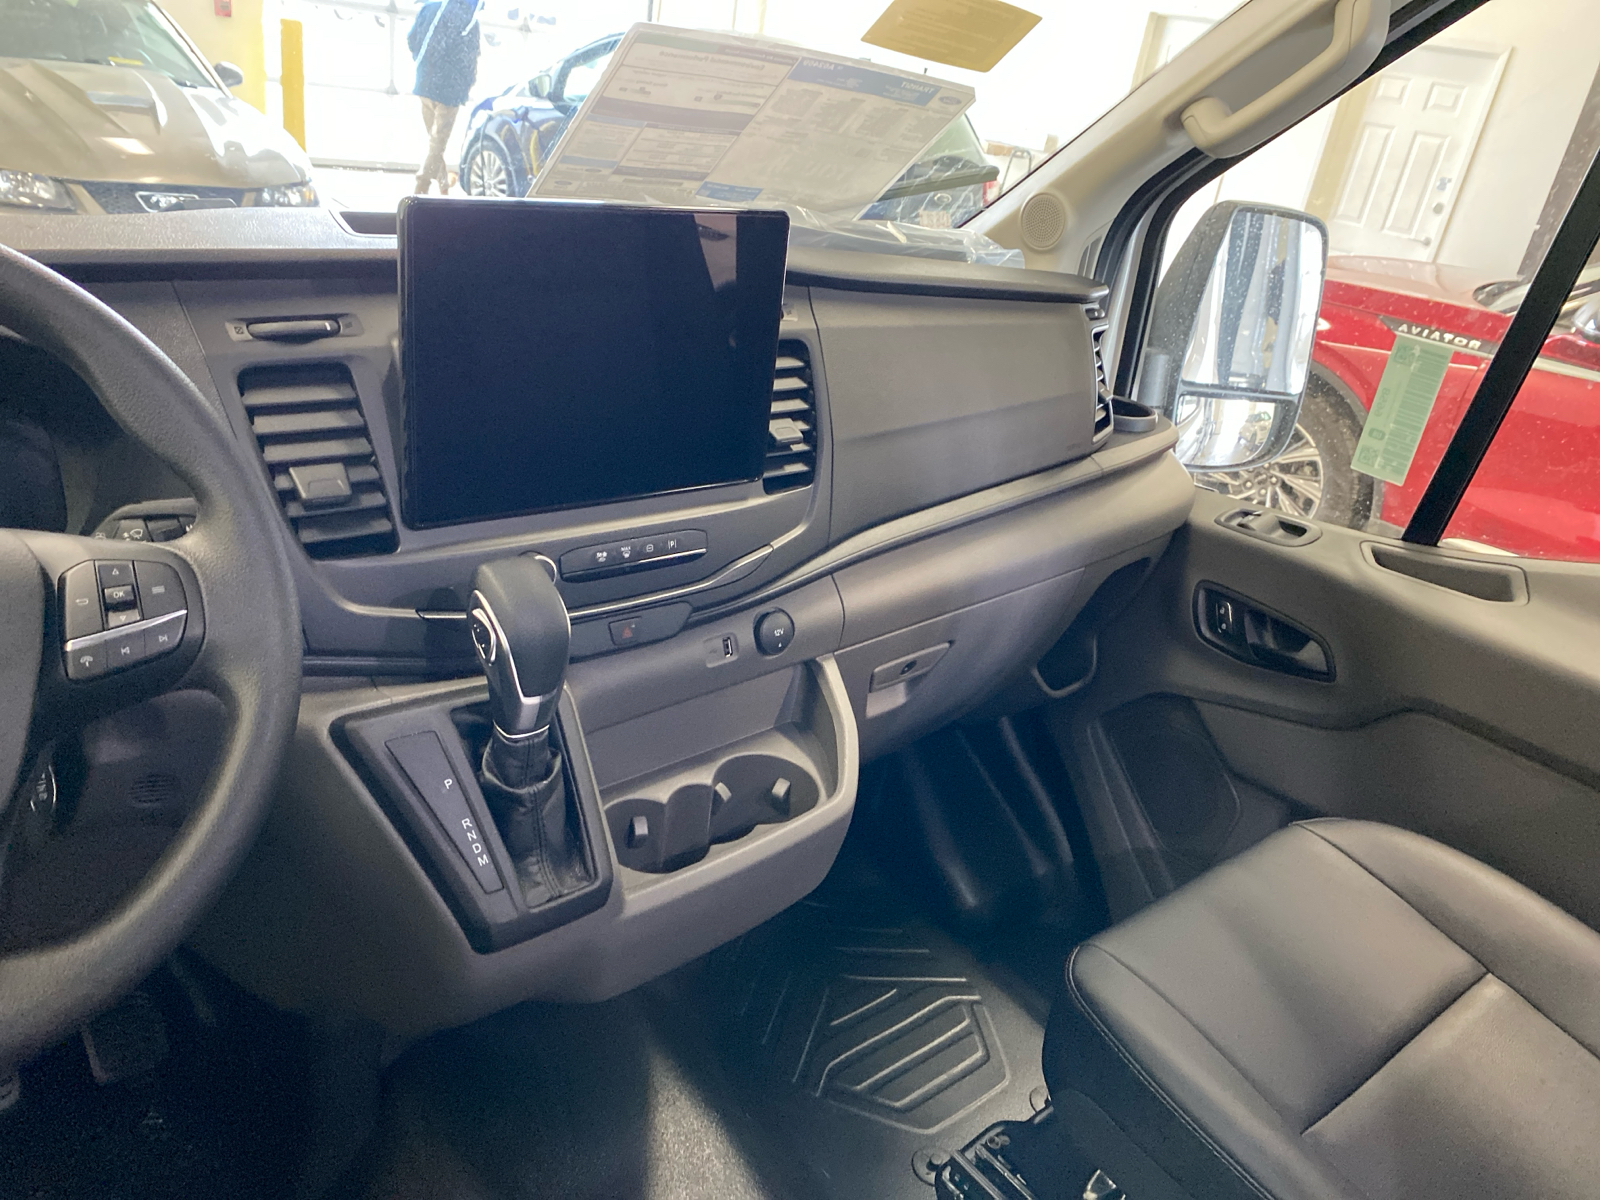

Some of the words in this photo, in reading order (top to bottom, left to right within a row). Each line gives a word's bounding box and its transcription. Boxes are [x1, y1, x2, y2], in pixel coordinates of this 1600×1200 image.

[1397, 323, 1482, 350] AVIATOR
[113, 591, 125, 599] OK
[774, 628, 784, 637] 12V
[444, 778, 453, 790] P
[461, 818, 472, 829] R
[467, 830, 477, 842] N
[472, 843, 482, 854] D
[477, 854, 489, 866] M
